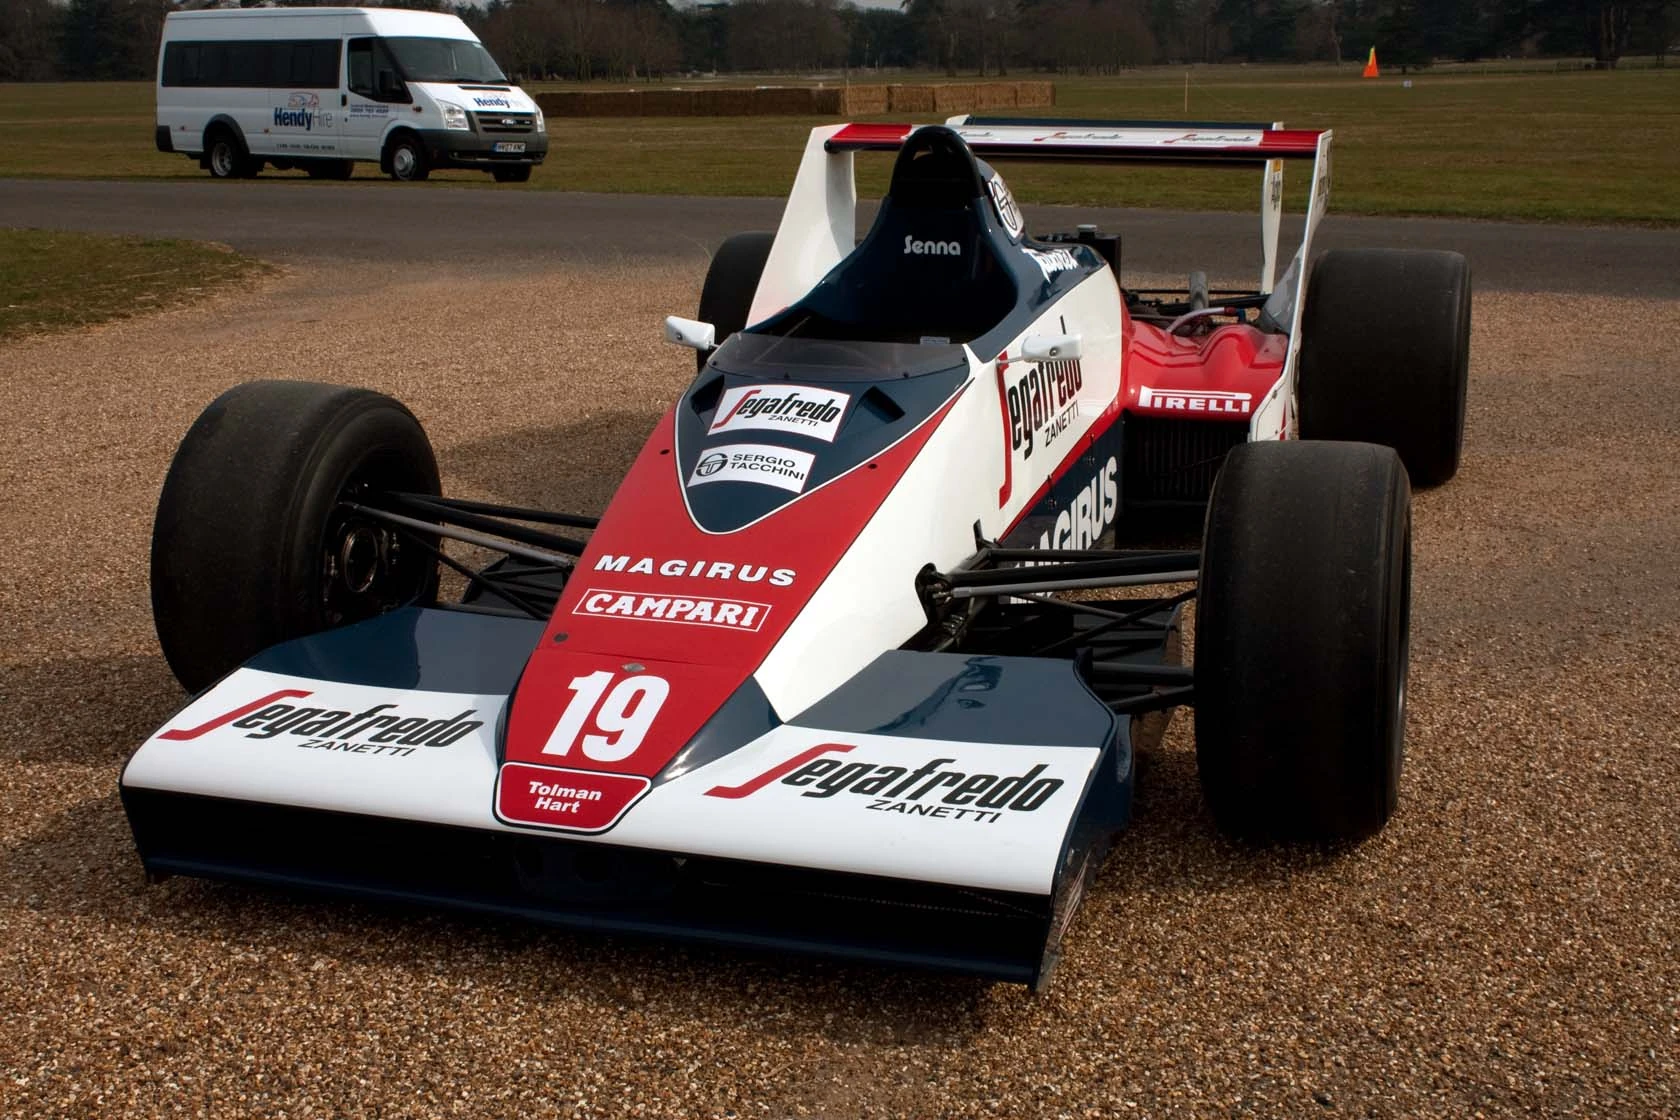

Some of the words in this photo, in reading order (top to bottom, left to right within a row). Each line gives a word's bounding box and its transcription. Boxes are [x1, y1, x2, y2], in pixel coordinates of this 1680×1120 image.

[903, 235, 961, 256] Senna
[711, 389, 841, 429] Segafredo
[1138, 385, 1252, 413] PIRELLI
[768, 414, 818, 427] ZANETTI
[1044, 400, 1079, 447] ZANETTI
[729, 461, 804, 481] TACCHINI
[732, 453, 796, 468] SERGIO
[593, 555, 797, 586] MAGIRUS
[585, 593, 759, 627] CAMPARI
[156, 689, 484, 748] Segafredo
[541, 670, 670, 762] 19
[298, 739, 416, 757] ZANETTI
[528, 780, 602, 801] Tolman
[703, 743, 1064, 812] Segafredo
[534, 796, 581, 813] Hart
[865, 799, 1002, 824] ZANETTI
